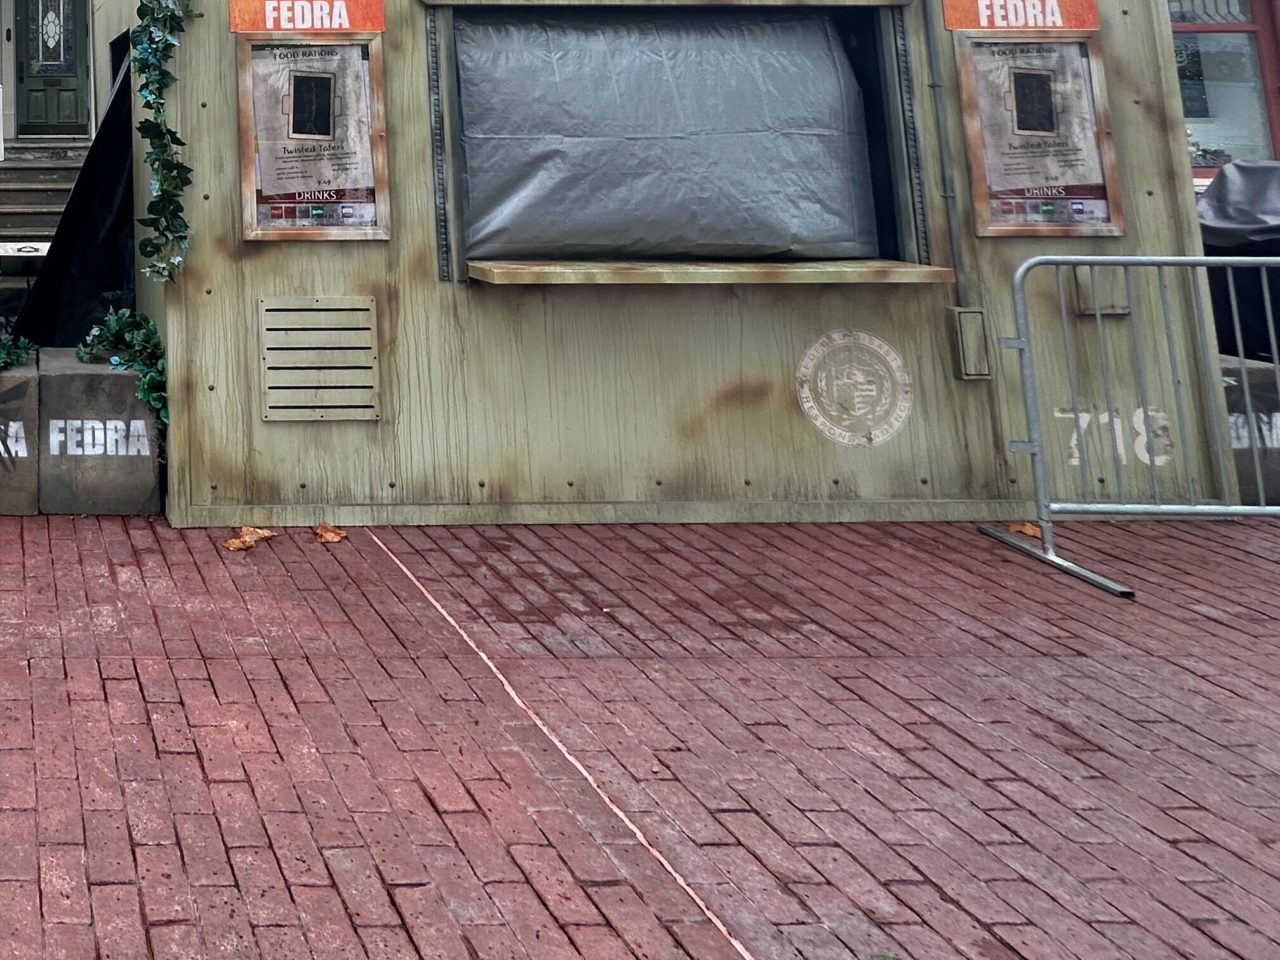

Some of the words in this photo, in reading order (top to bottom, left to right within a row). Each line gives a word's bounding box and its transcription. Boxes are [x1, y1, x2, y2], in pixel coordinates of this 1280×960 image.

[264, 0, 350, 29] FEDRA
[273, 50, 299, 60] FOOD
[302, 48, 339, 58] RATIONS
[282, 145, 316, 155] Twisted
[295, 190, 337, 201] DRINKS
[1024, 186, 1066, 197] DRINKS
[48, 418, 151, 457] FEDRA
